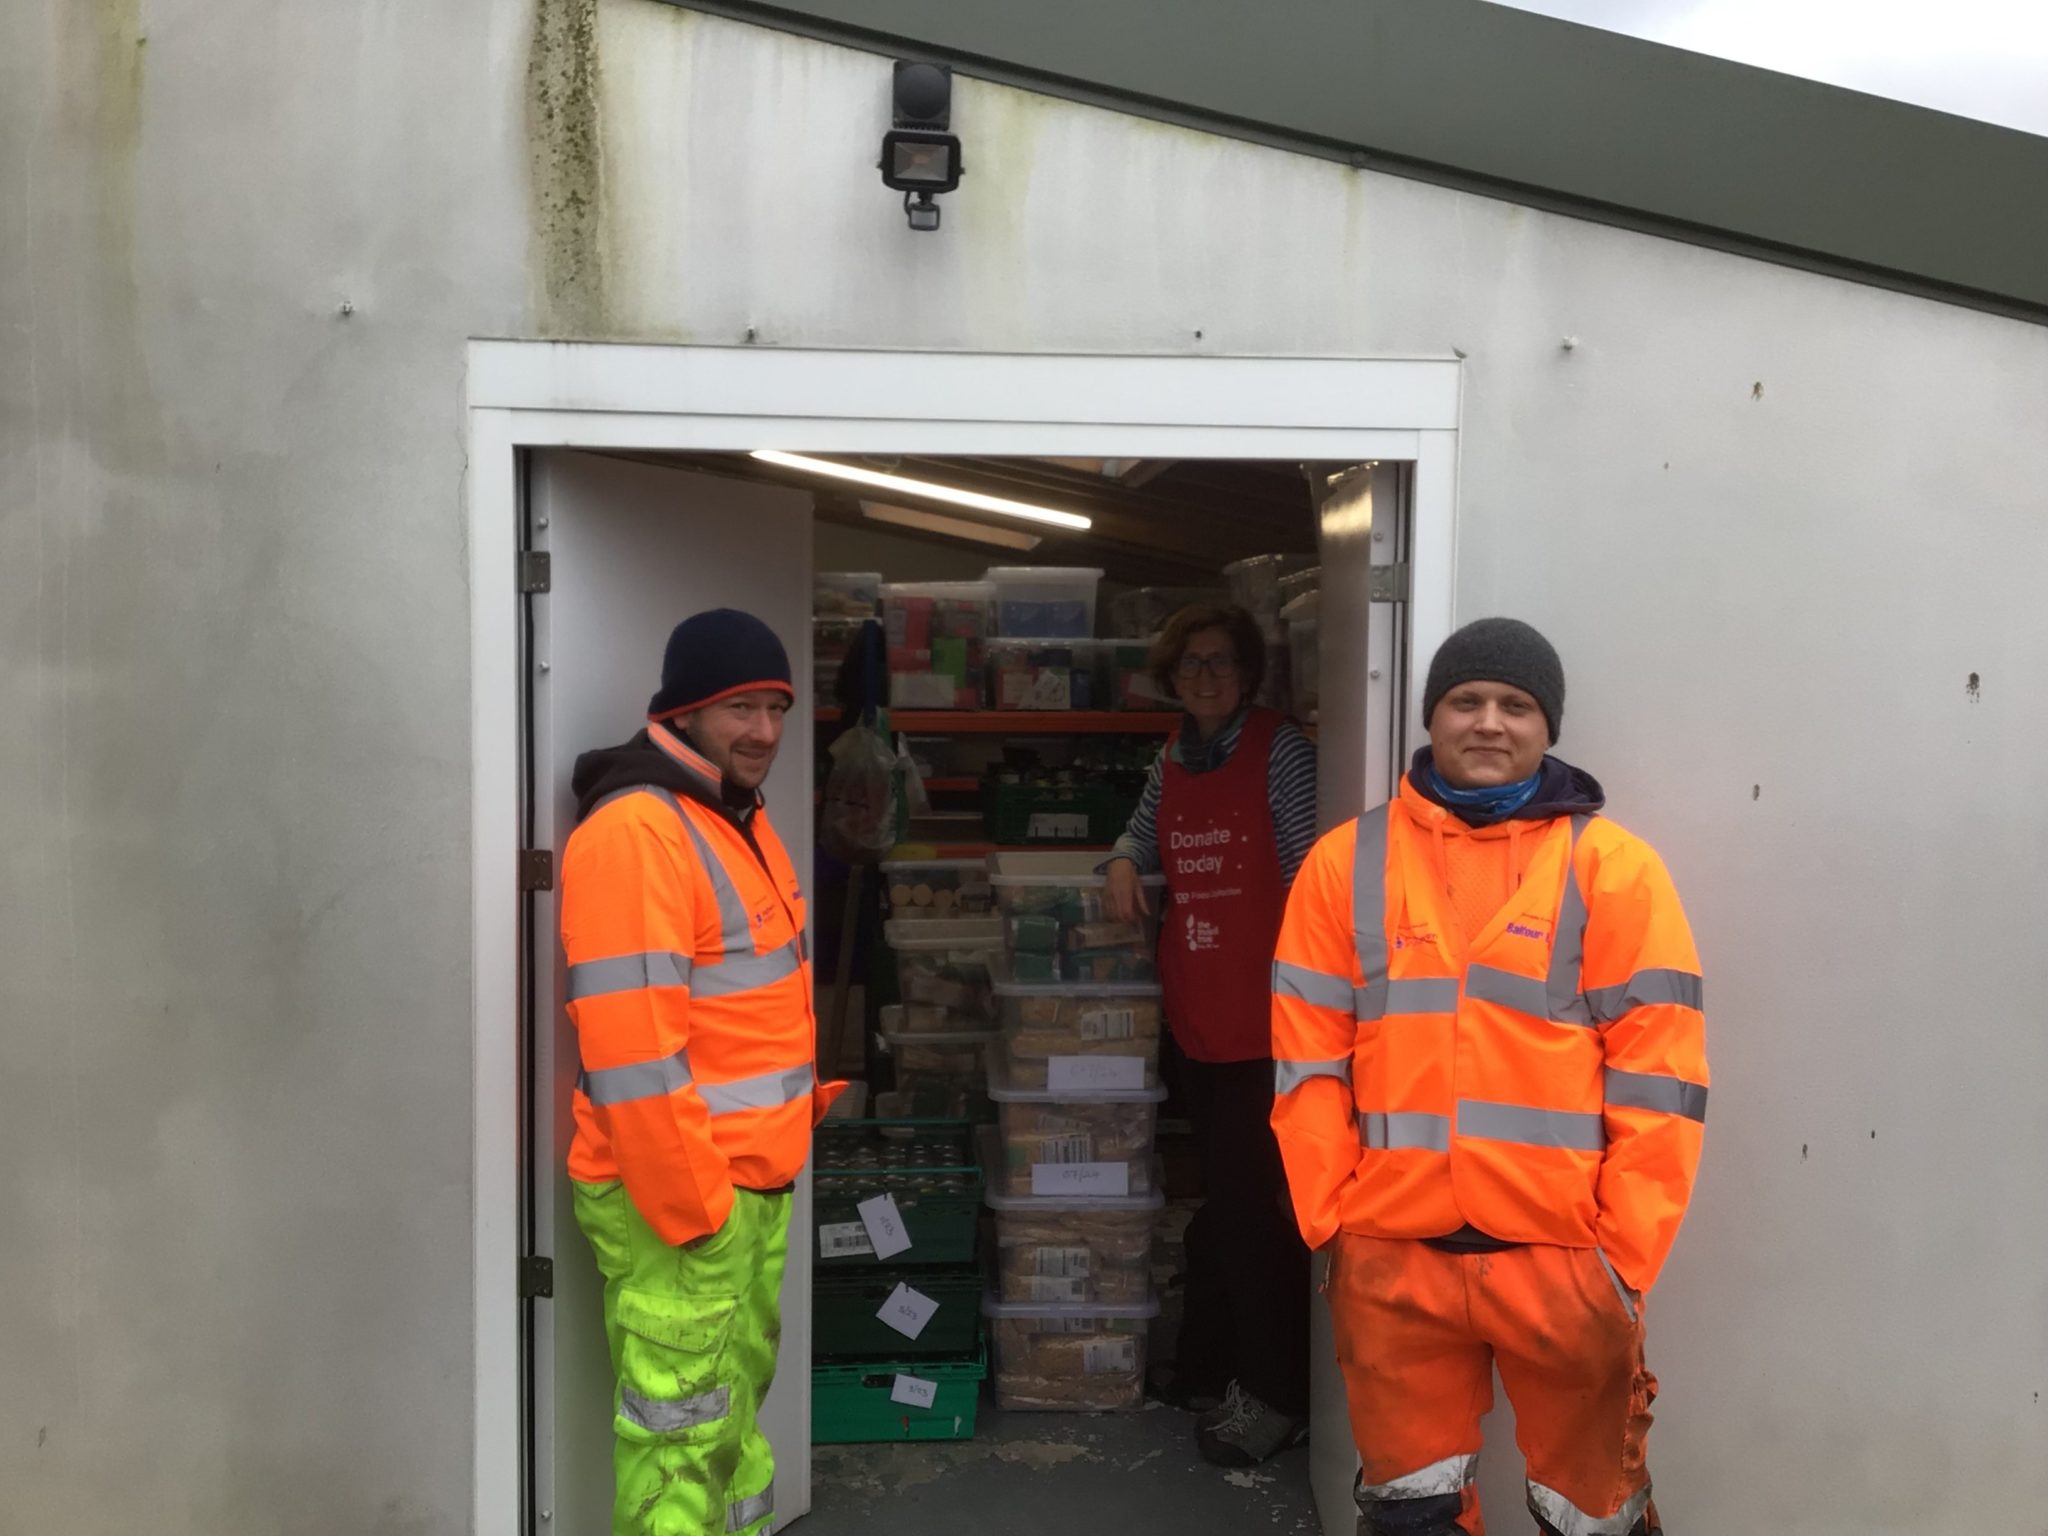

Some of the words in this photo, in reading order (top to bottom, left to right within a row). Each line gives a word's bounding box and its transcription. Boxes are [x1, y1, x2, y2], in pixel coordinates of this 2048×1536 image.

[1171, 828, 1231, 850] Donate
[1176, 854, 1224, 874] today
[1506, 922, 1544, 939] Balfour
